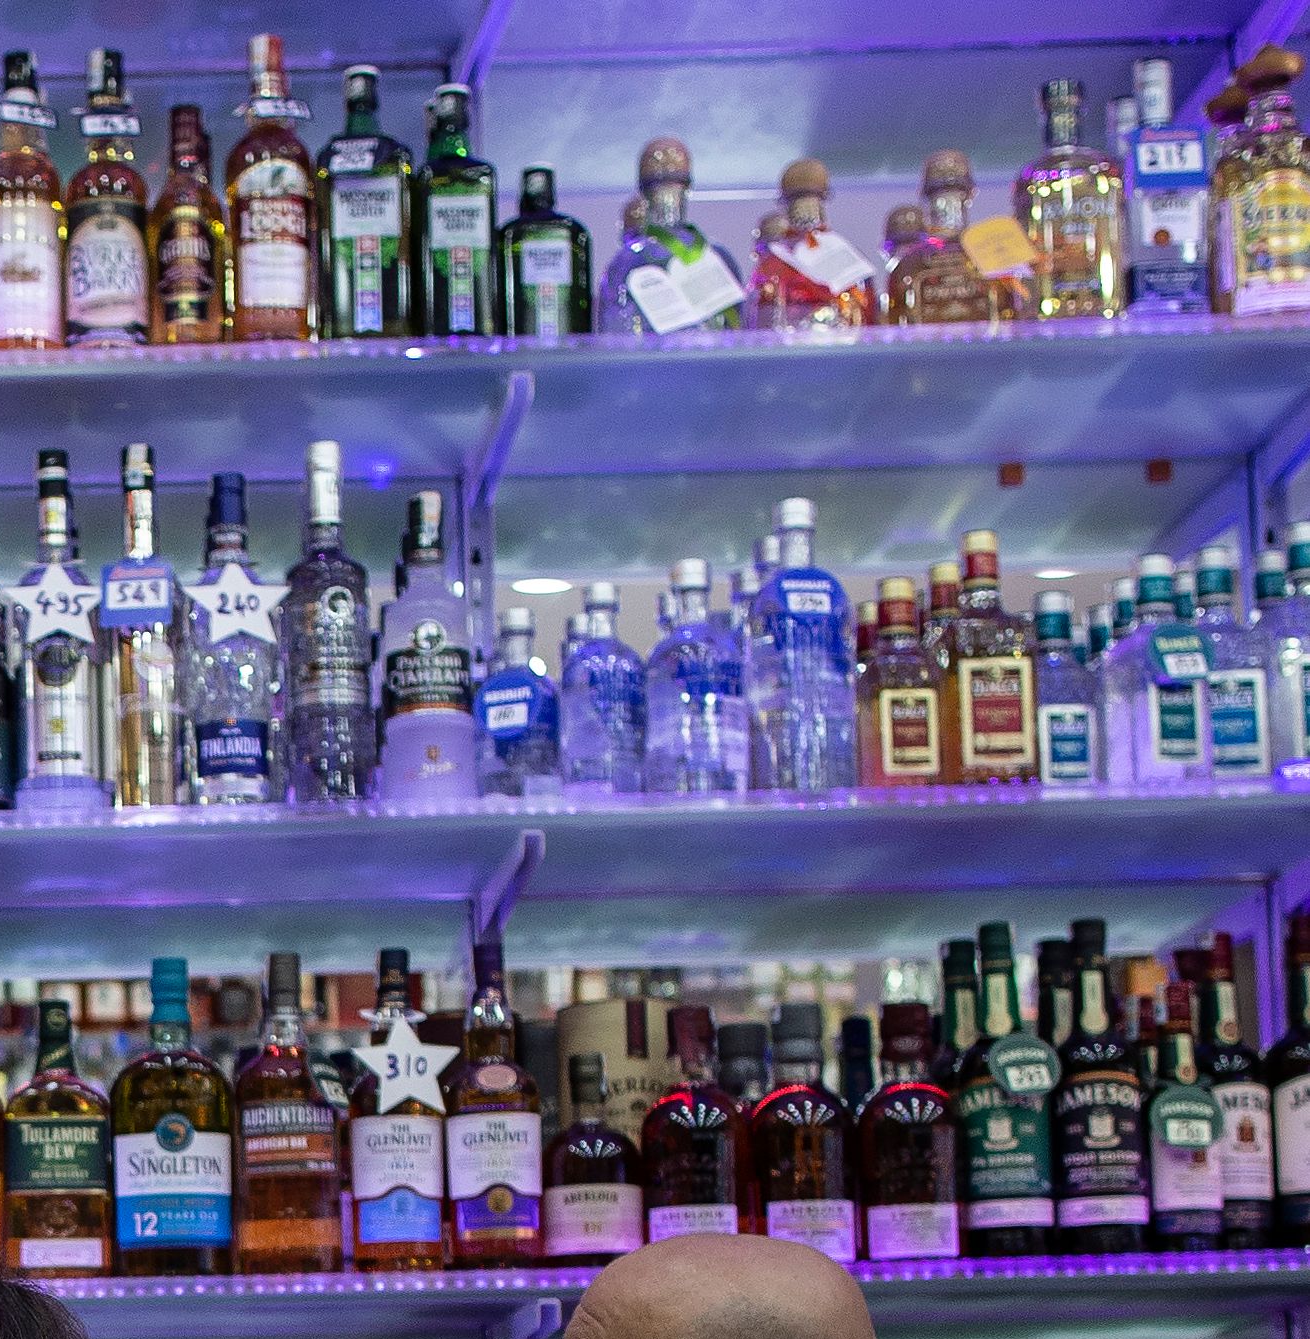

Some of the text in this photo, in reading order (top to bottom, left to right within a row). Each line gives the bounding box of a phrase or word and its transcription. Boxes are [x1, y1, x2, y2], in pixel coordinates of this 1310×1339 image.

[36, 591, 86, 616] 495
[115, 580, 162, 603] 549
[217, 589, 260, 615] 240
[200, 736, 264, 758] FINLANDIA
[386, 1053, 429, 1080] 310
[21, 1123, 99, 1144] TULLAMORE
[43, 1144, 77, 1160] DEW
[129, 1152, 223, 1178] SINGLETON
[133, 1213, 159, 1238] 12
